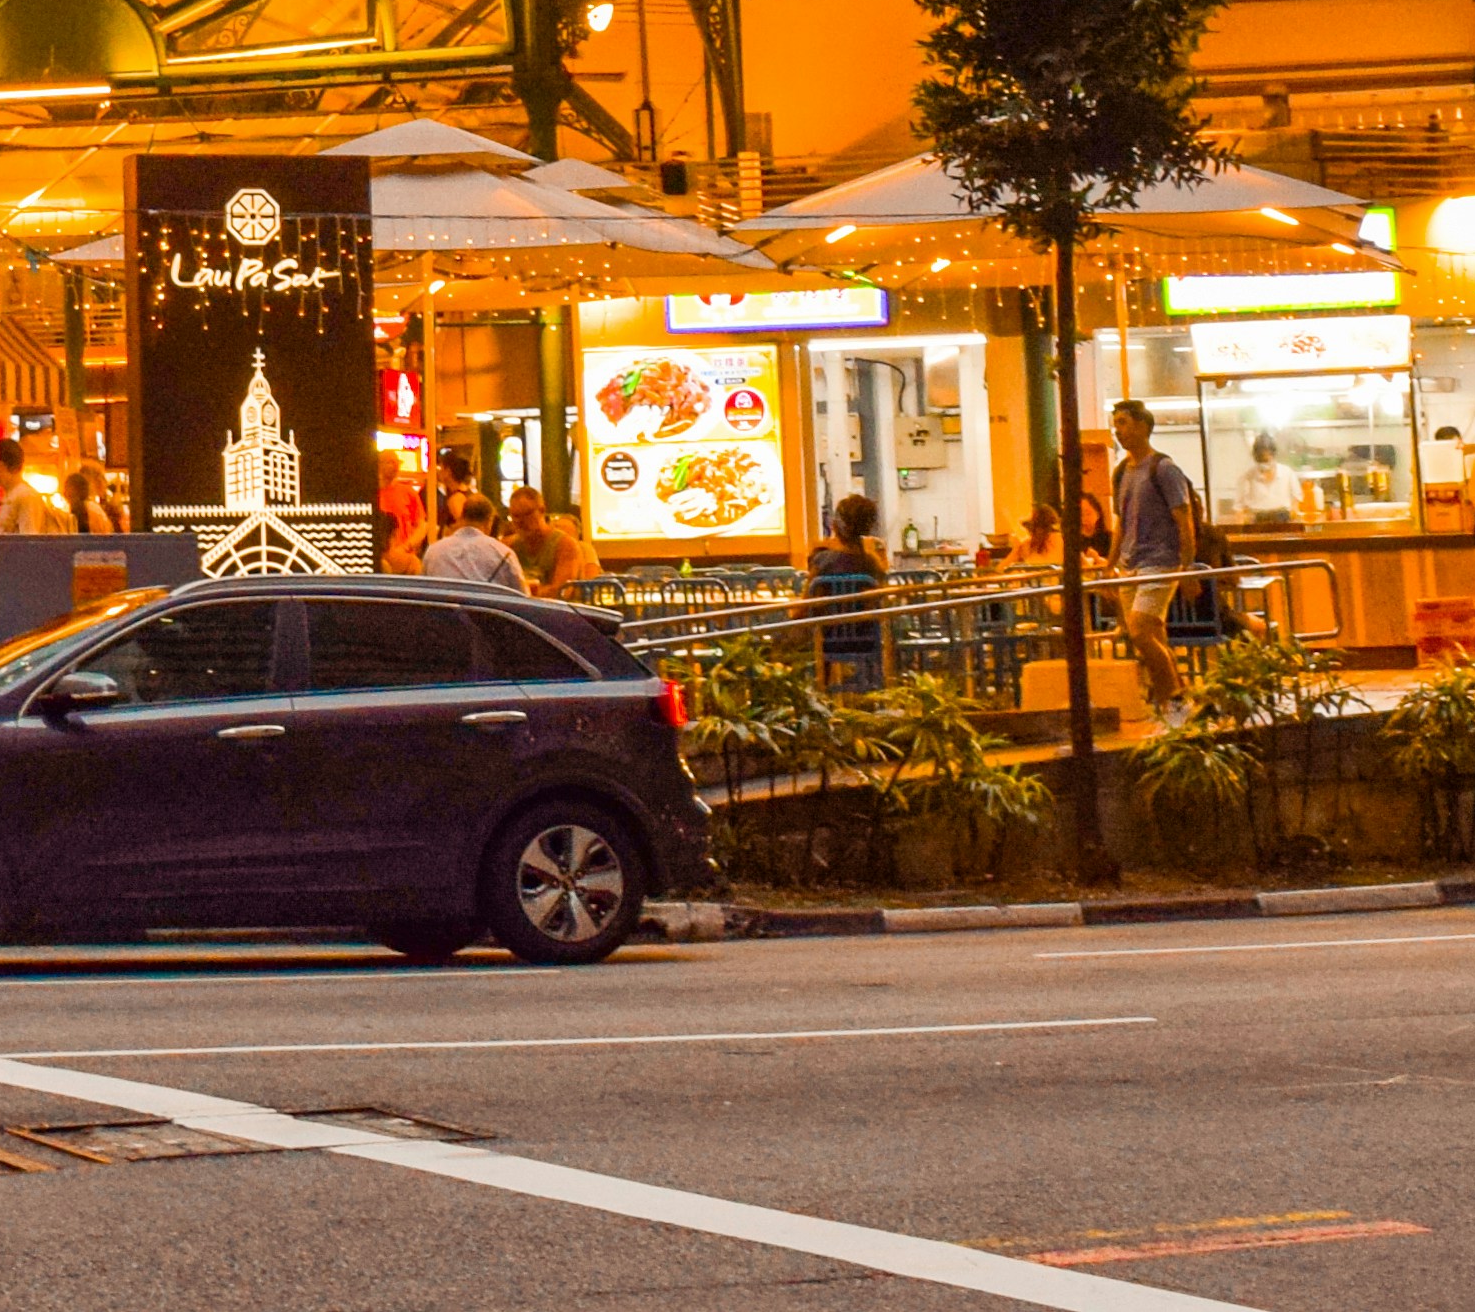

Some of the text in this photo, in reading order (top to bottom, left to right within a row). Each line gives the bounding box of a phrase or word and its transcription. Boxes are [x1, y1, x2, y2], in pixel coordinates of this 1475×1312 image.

[170, 252, 341, 292] Lau Pa Sat
